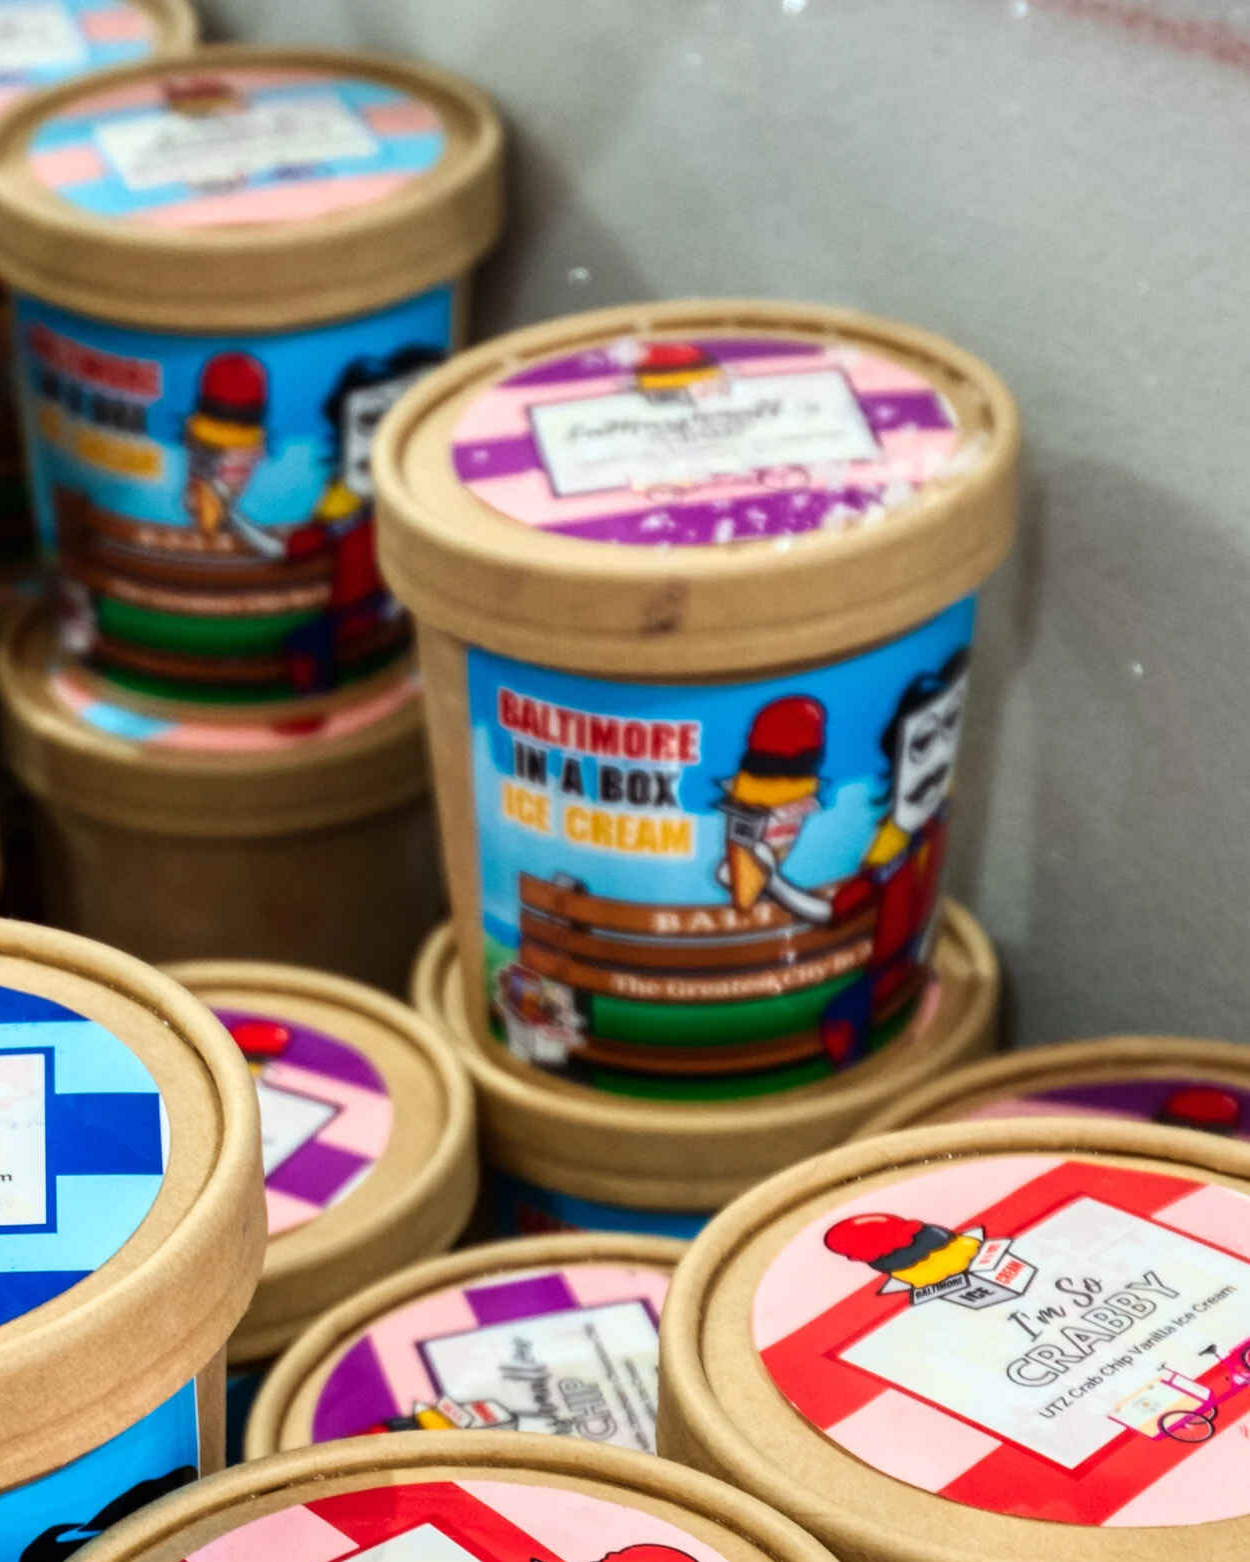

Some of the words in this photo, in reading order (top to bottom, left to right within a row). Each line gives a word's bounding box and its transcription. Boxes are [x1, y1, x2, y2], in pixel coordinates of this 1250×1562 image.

[498, 686, 701, 764] BALTIMORE
[512, 739, 548, 788] IN
[560, 756, 585, 799] A
[599, 764, 677, 808] BOX
[502, 781, 549, 835] ICE
[562, 804, 693, 856] CREAM
[958, 1286, 995, 1302] ICE
[1006, 1269, 1181, 1387] CRABBY
[1007, 1304, 1067, 1342] I'm
[1054, 1276, 1103, 1308] So
[1039, 1395, 1075, 1420] UTZ
[1068, 1375, 1104, 1399] Crab
[1099, 1353, 1134, 1377] Chip
[1127, 1324, 1177, 1355] Vanilla
[1171, 1311, 1197, 1328] Ice
[1192, 1285, 1237, 1313] Cream
